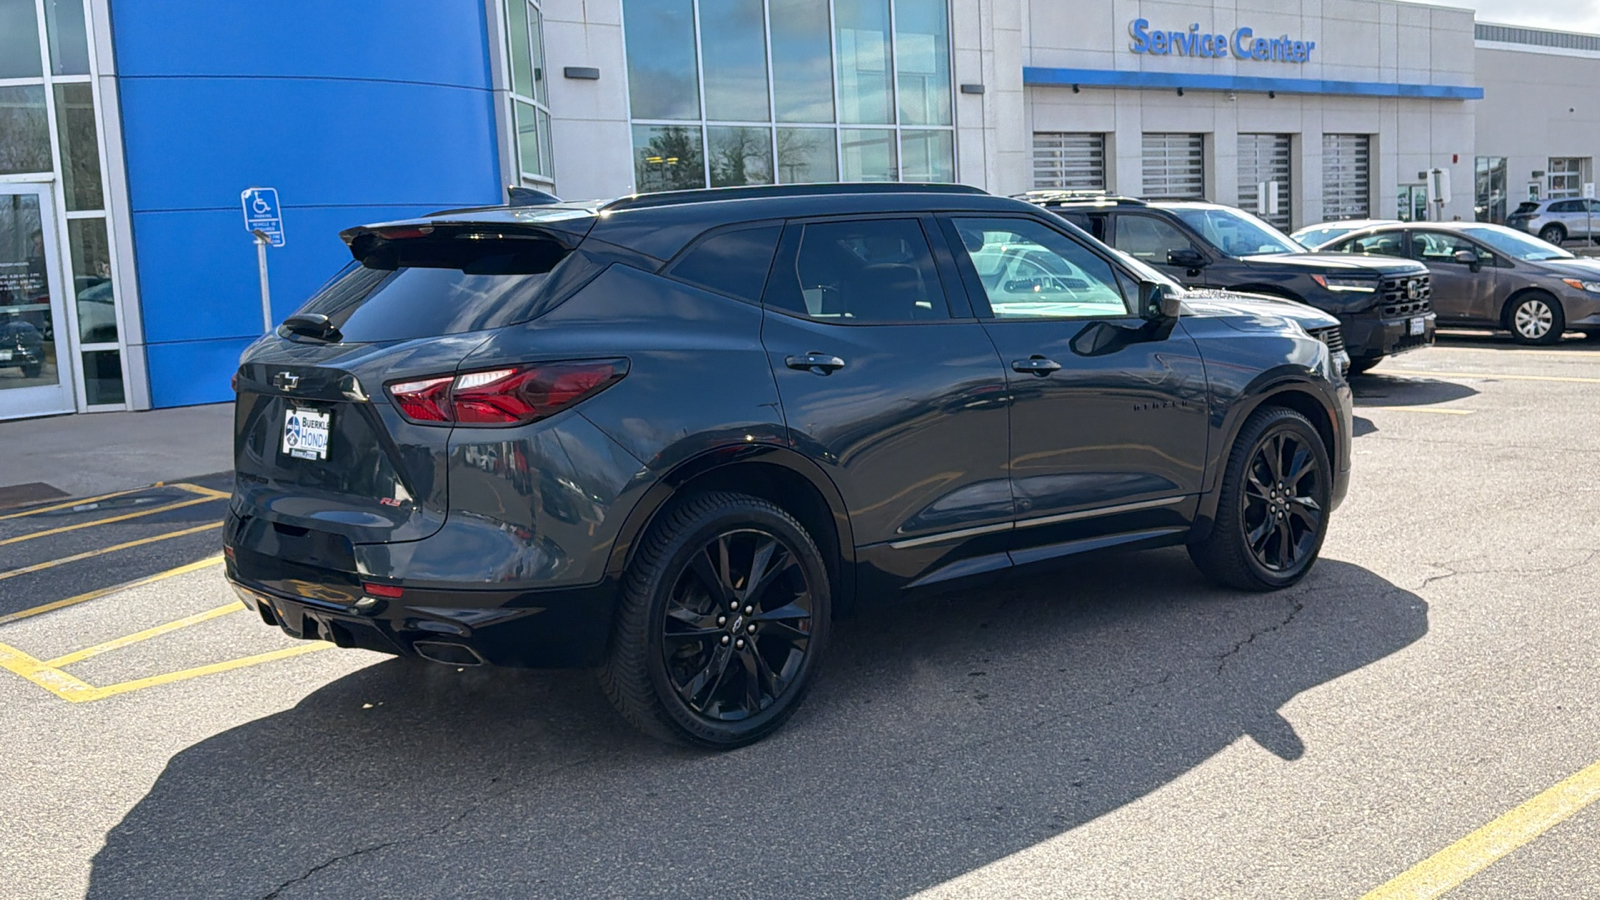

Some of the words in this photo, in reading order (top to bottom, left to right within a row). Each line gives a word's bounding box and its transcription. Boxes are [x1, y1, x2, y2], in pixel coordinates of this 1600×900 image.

[1129, 18, 1228, 58] Service
[1230, 26, 1316, 64] Center
[301, 428, 328, 448] HONDA
[379, 497, 401, 507] RS
